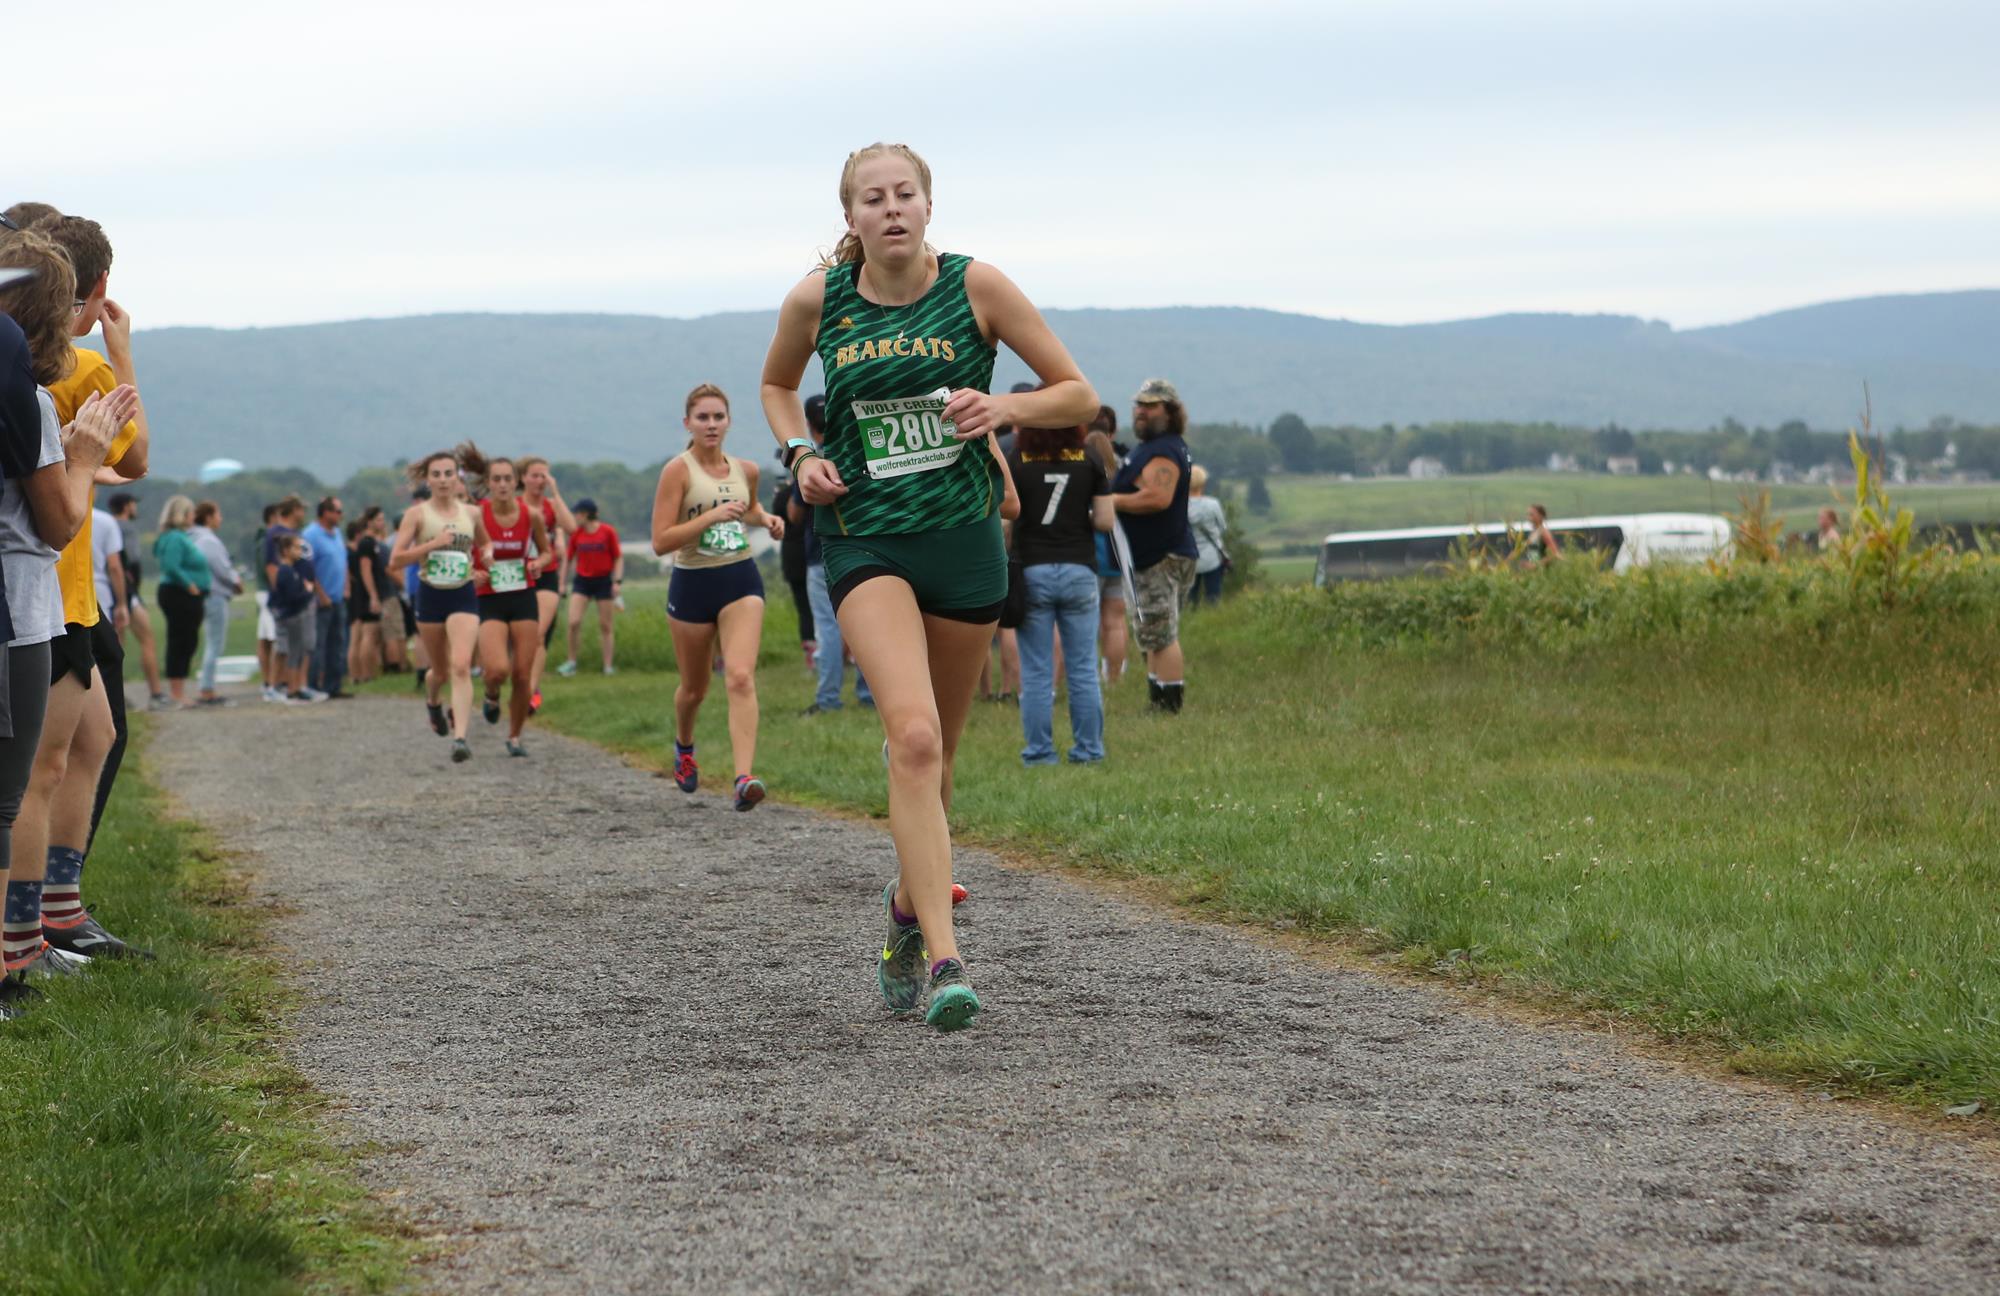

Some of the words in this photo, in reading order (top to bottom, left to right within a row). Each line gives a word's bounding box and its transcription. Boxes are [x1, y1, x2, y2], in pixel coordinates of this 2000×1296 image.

[837, 337, 956, 368] BEARCATS
[862, 402, 900, 416] WOLF
[903, 396, 946, 411] CREEK
[881, 411, 943, 455] 280
[876, 449, 961, 472] wolfcreektrackclub.com
[1041, 473, 1070, 525] 7
